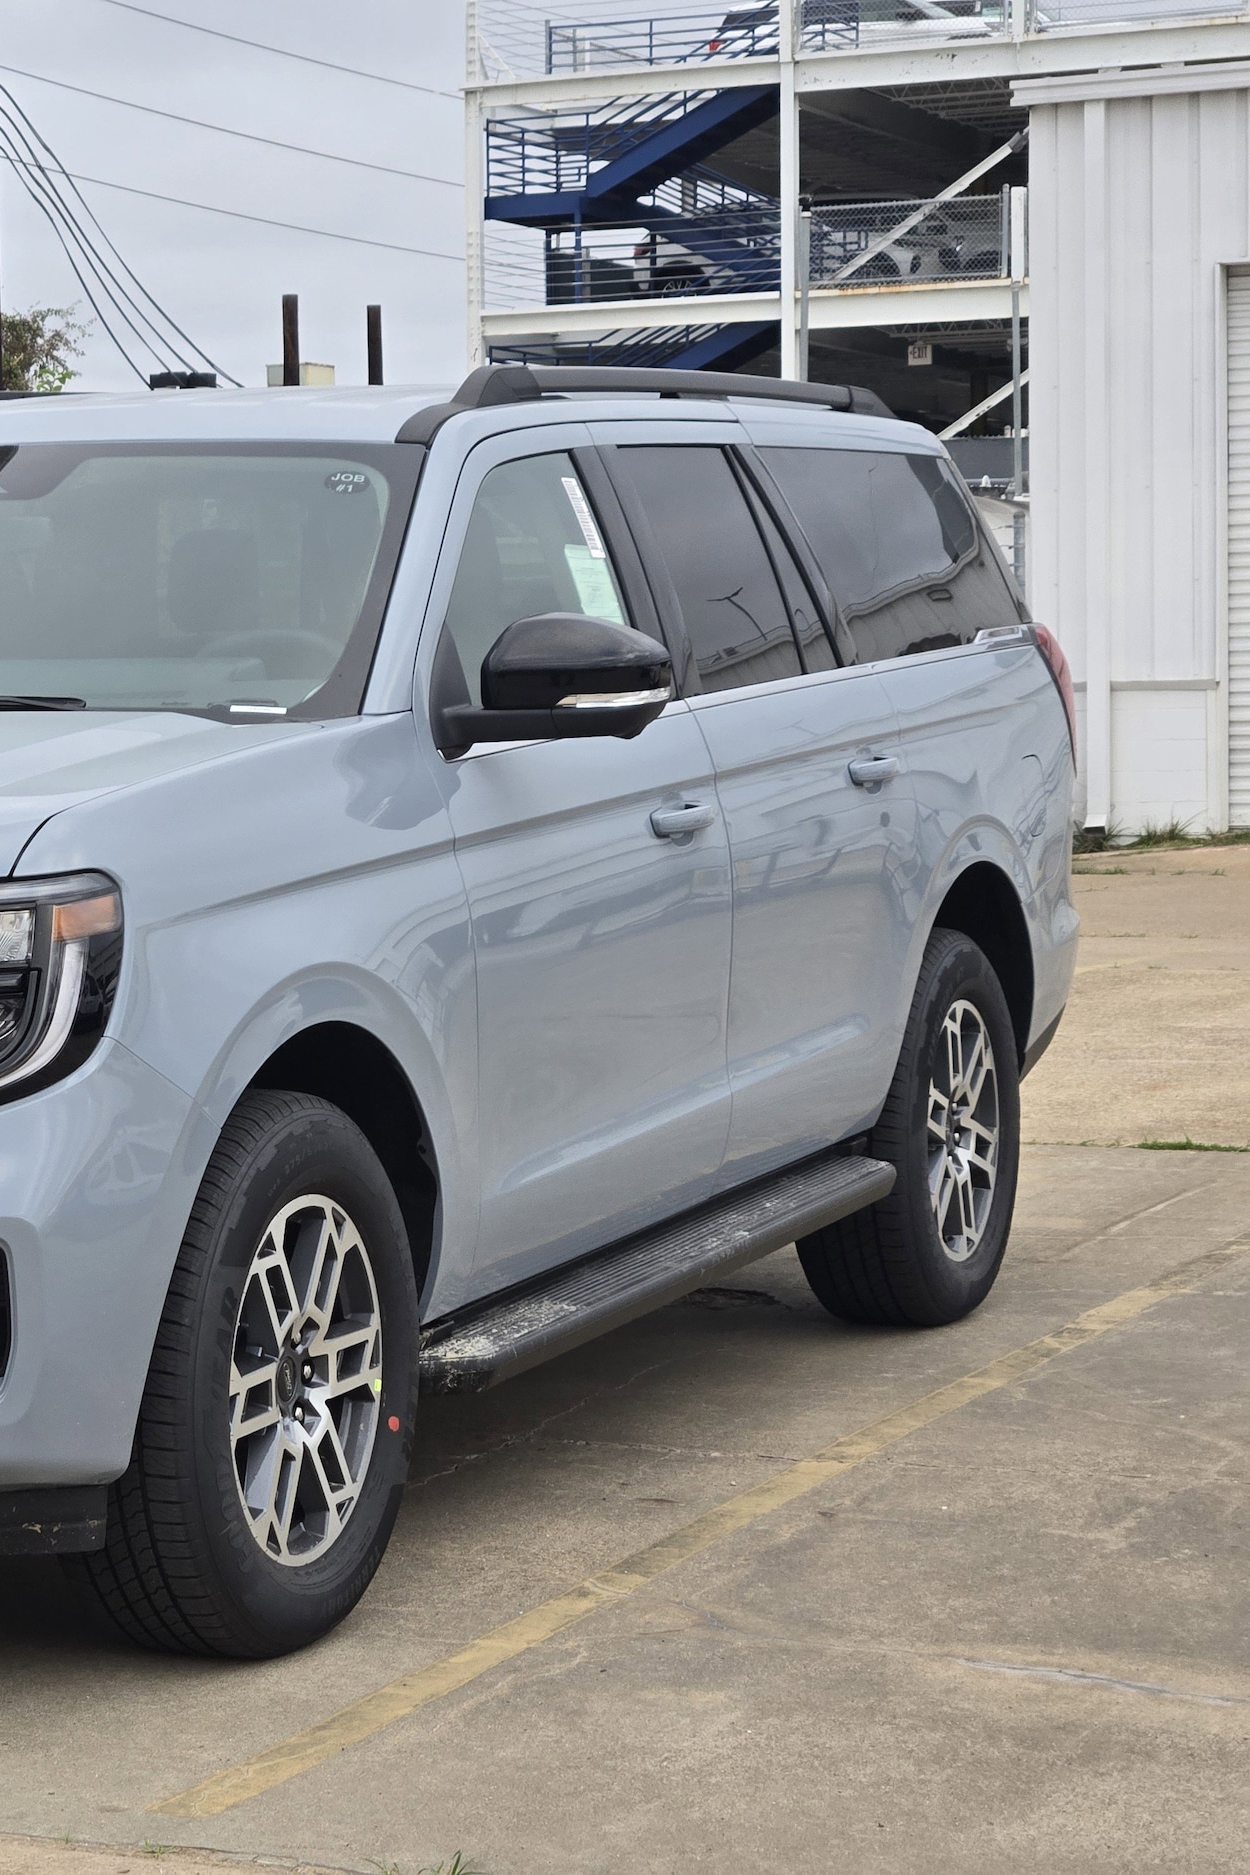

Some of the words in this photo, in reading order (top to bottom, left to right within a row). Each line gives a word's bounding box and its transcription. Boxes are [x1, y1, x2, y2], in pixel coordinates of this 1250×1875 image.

[913, 346, 927, 359] EXIT
[331, 473, 365, 482] JOB
[336, 484, 353, 492] #1
